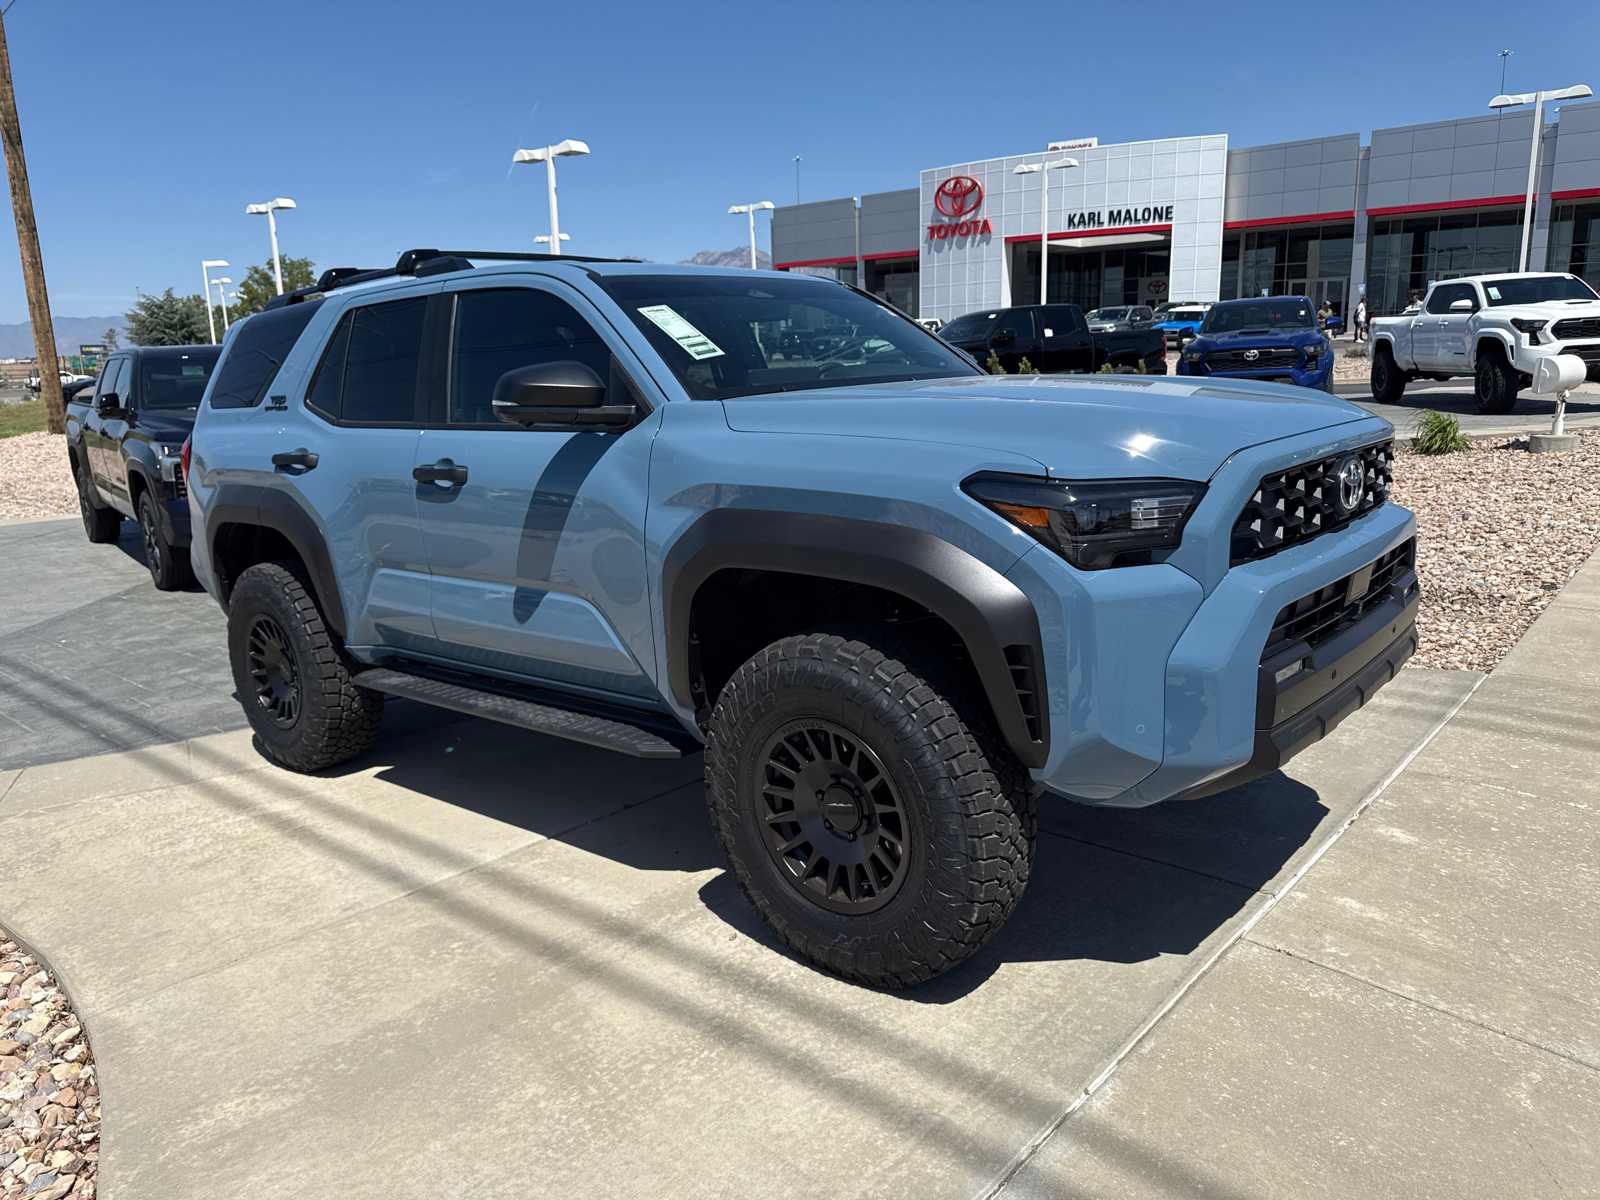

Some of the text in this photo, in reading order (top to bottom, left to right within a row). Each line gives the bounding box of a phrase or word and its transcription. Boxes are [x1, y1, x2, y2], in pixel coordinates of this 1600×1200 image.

[1068, 205, 1174, 229] KARL MALONE
[927, 219, 993, 241] TOYOTA
